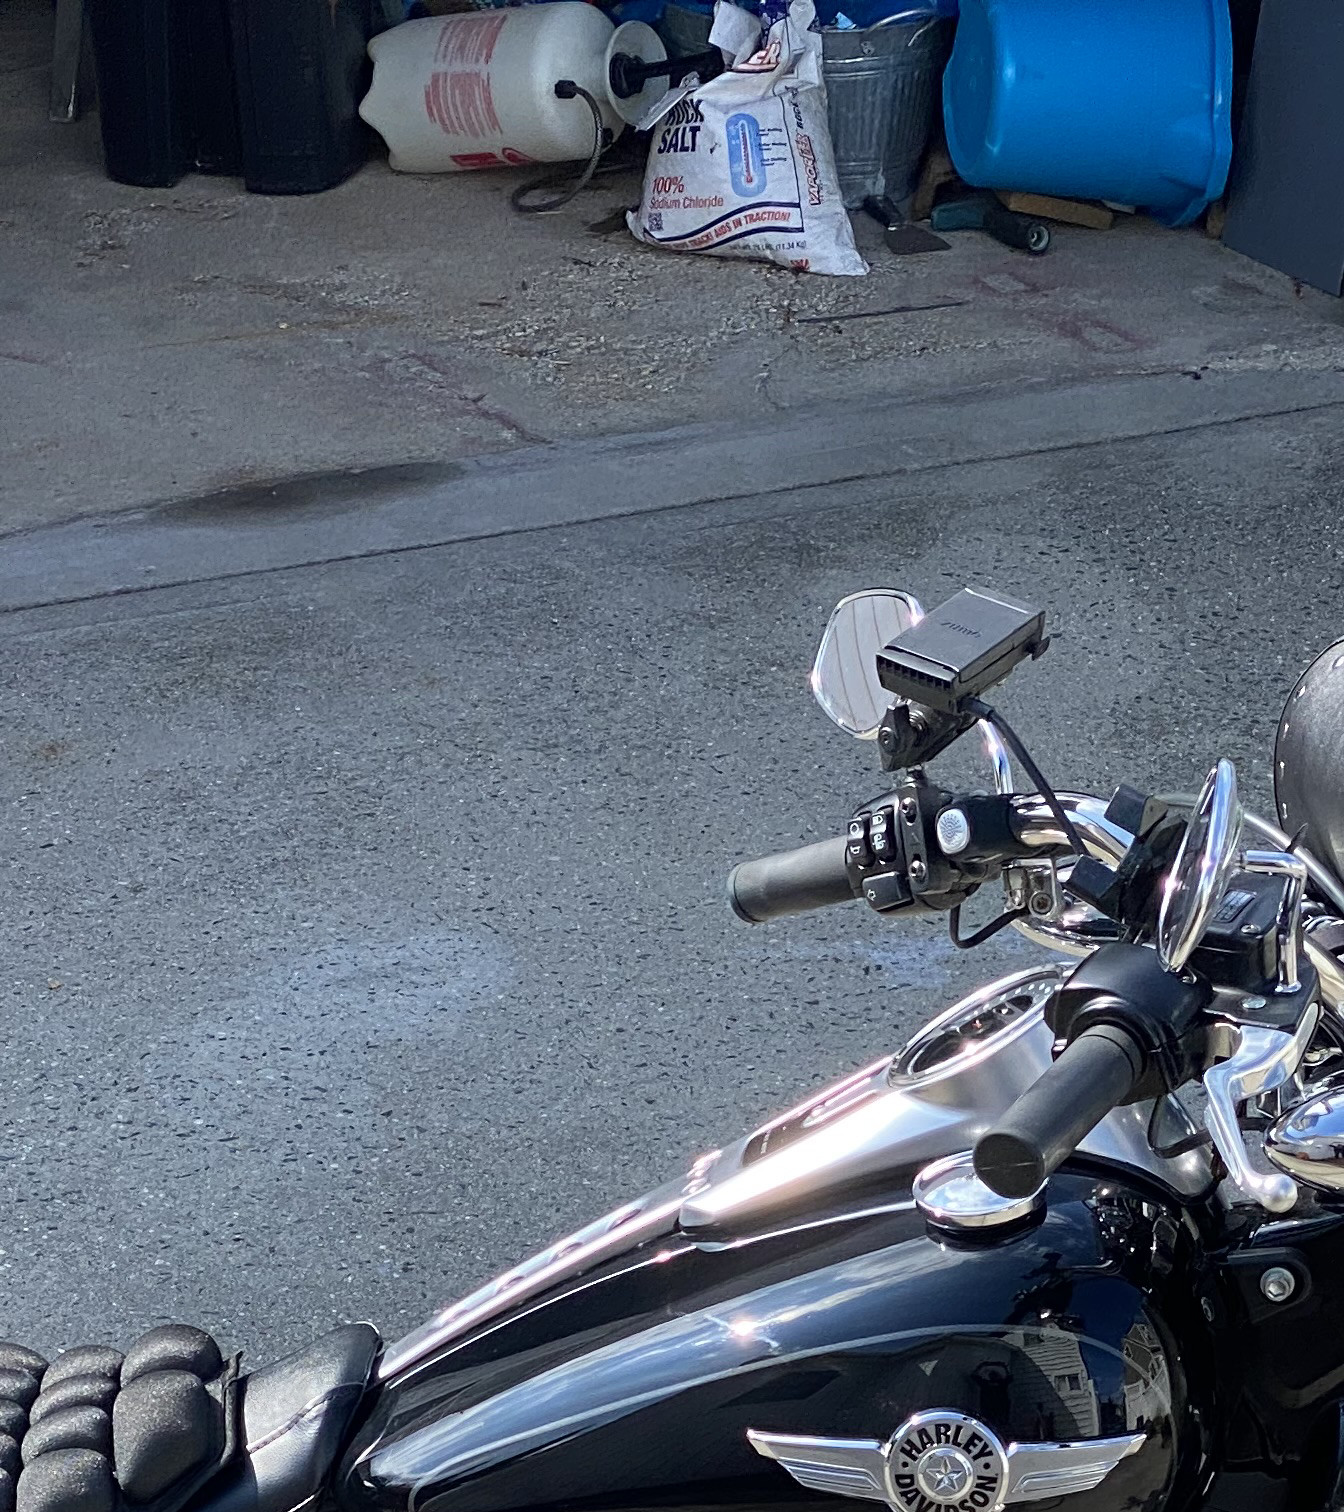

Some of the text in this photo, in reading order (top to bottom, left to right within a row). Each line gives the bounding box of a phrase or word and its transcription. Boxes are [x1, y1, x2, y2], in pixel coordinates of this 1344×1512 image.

[658, 125, 701, 154] SALT
[652, 176, 685, 194] 100%
[682, 196, 725, 209] Chloride
[745, 210, 791, 225] TRACTION!
[899, 1423, 994, 1463] HARLEY
